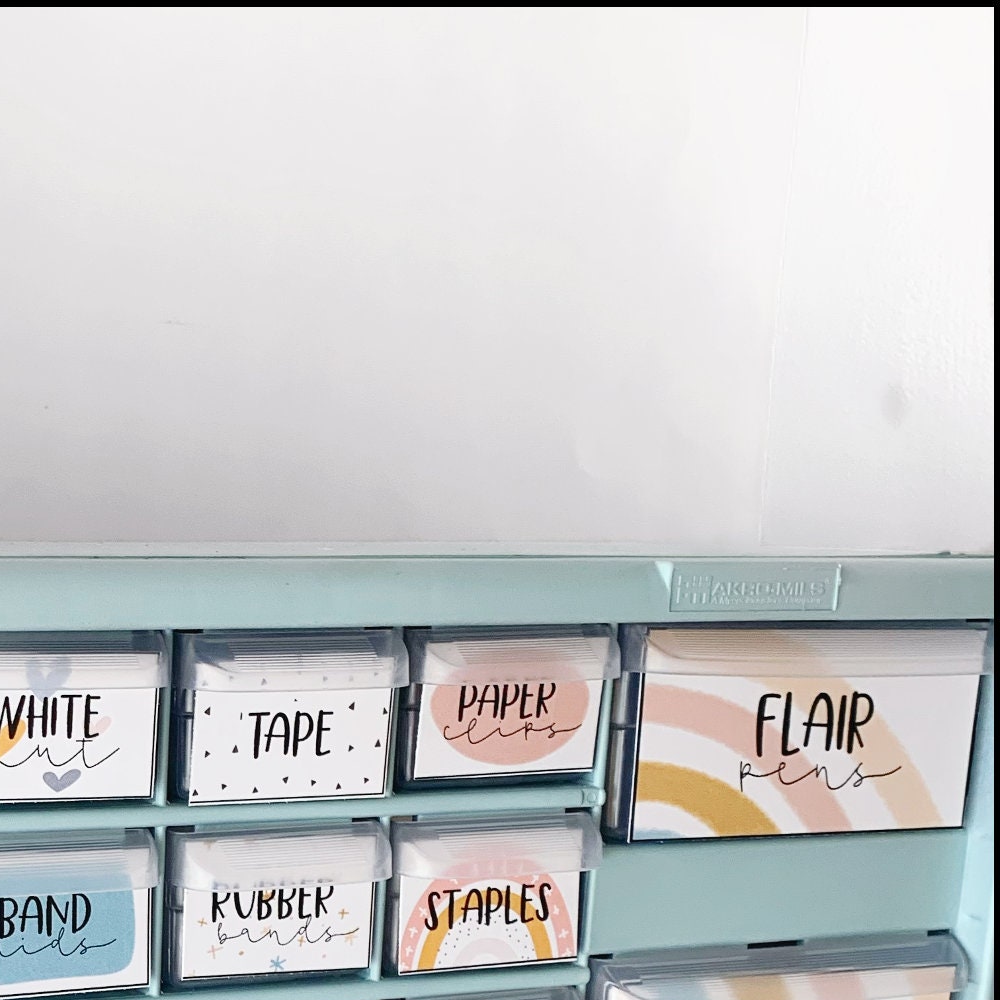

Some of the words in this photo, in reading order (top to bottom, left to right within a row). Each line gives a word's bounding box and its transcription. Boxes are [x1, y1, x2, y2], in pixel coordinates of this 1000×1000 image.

[458, 678, 556, 722] PAPER
[248, 710, 334, 759] TAPE
[443, 718, 582, 744] clips
[755, 691, 874, 757] FLAIR
[739, 760, 902, 792] pens
[212, 879, 334, 923] RUBBER
[424, 882, 551, 932] STAPLES
[217, 915, 360, 946] bands
